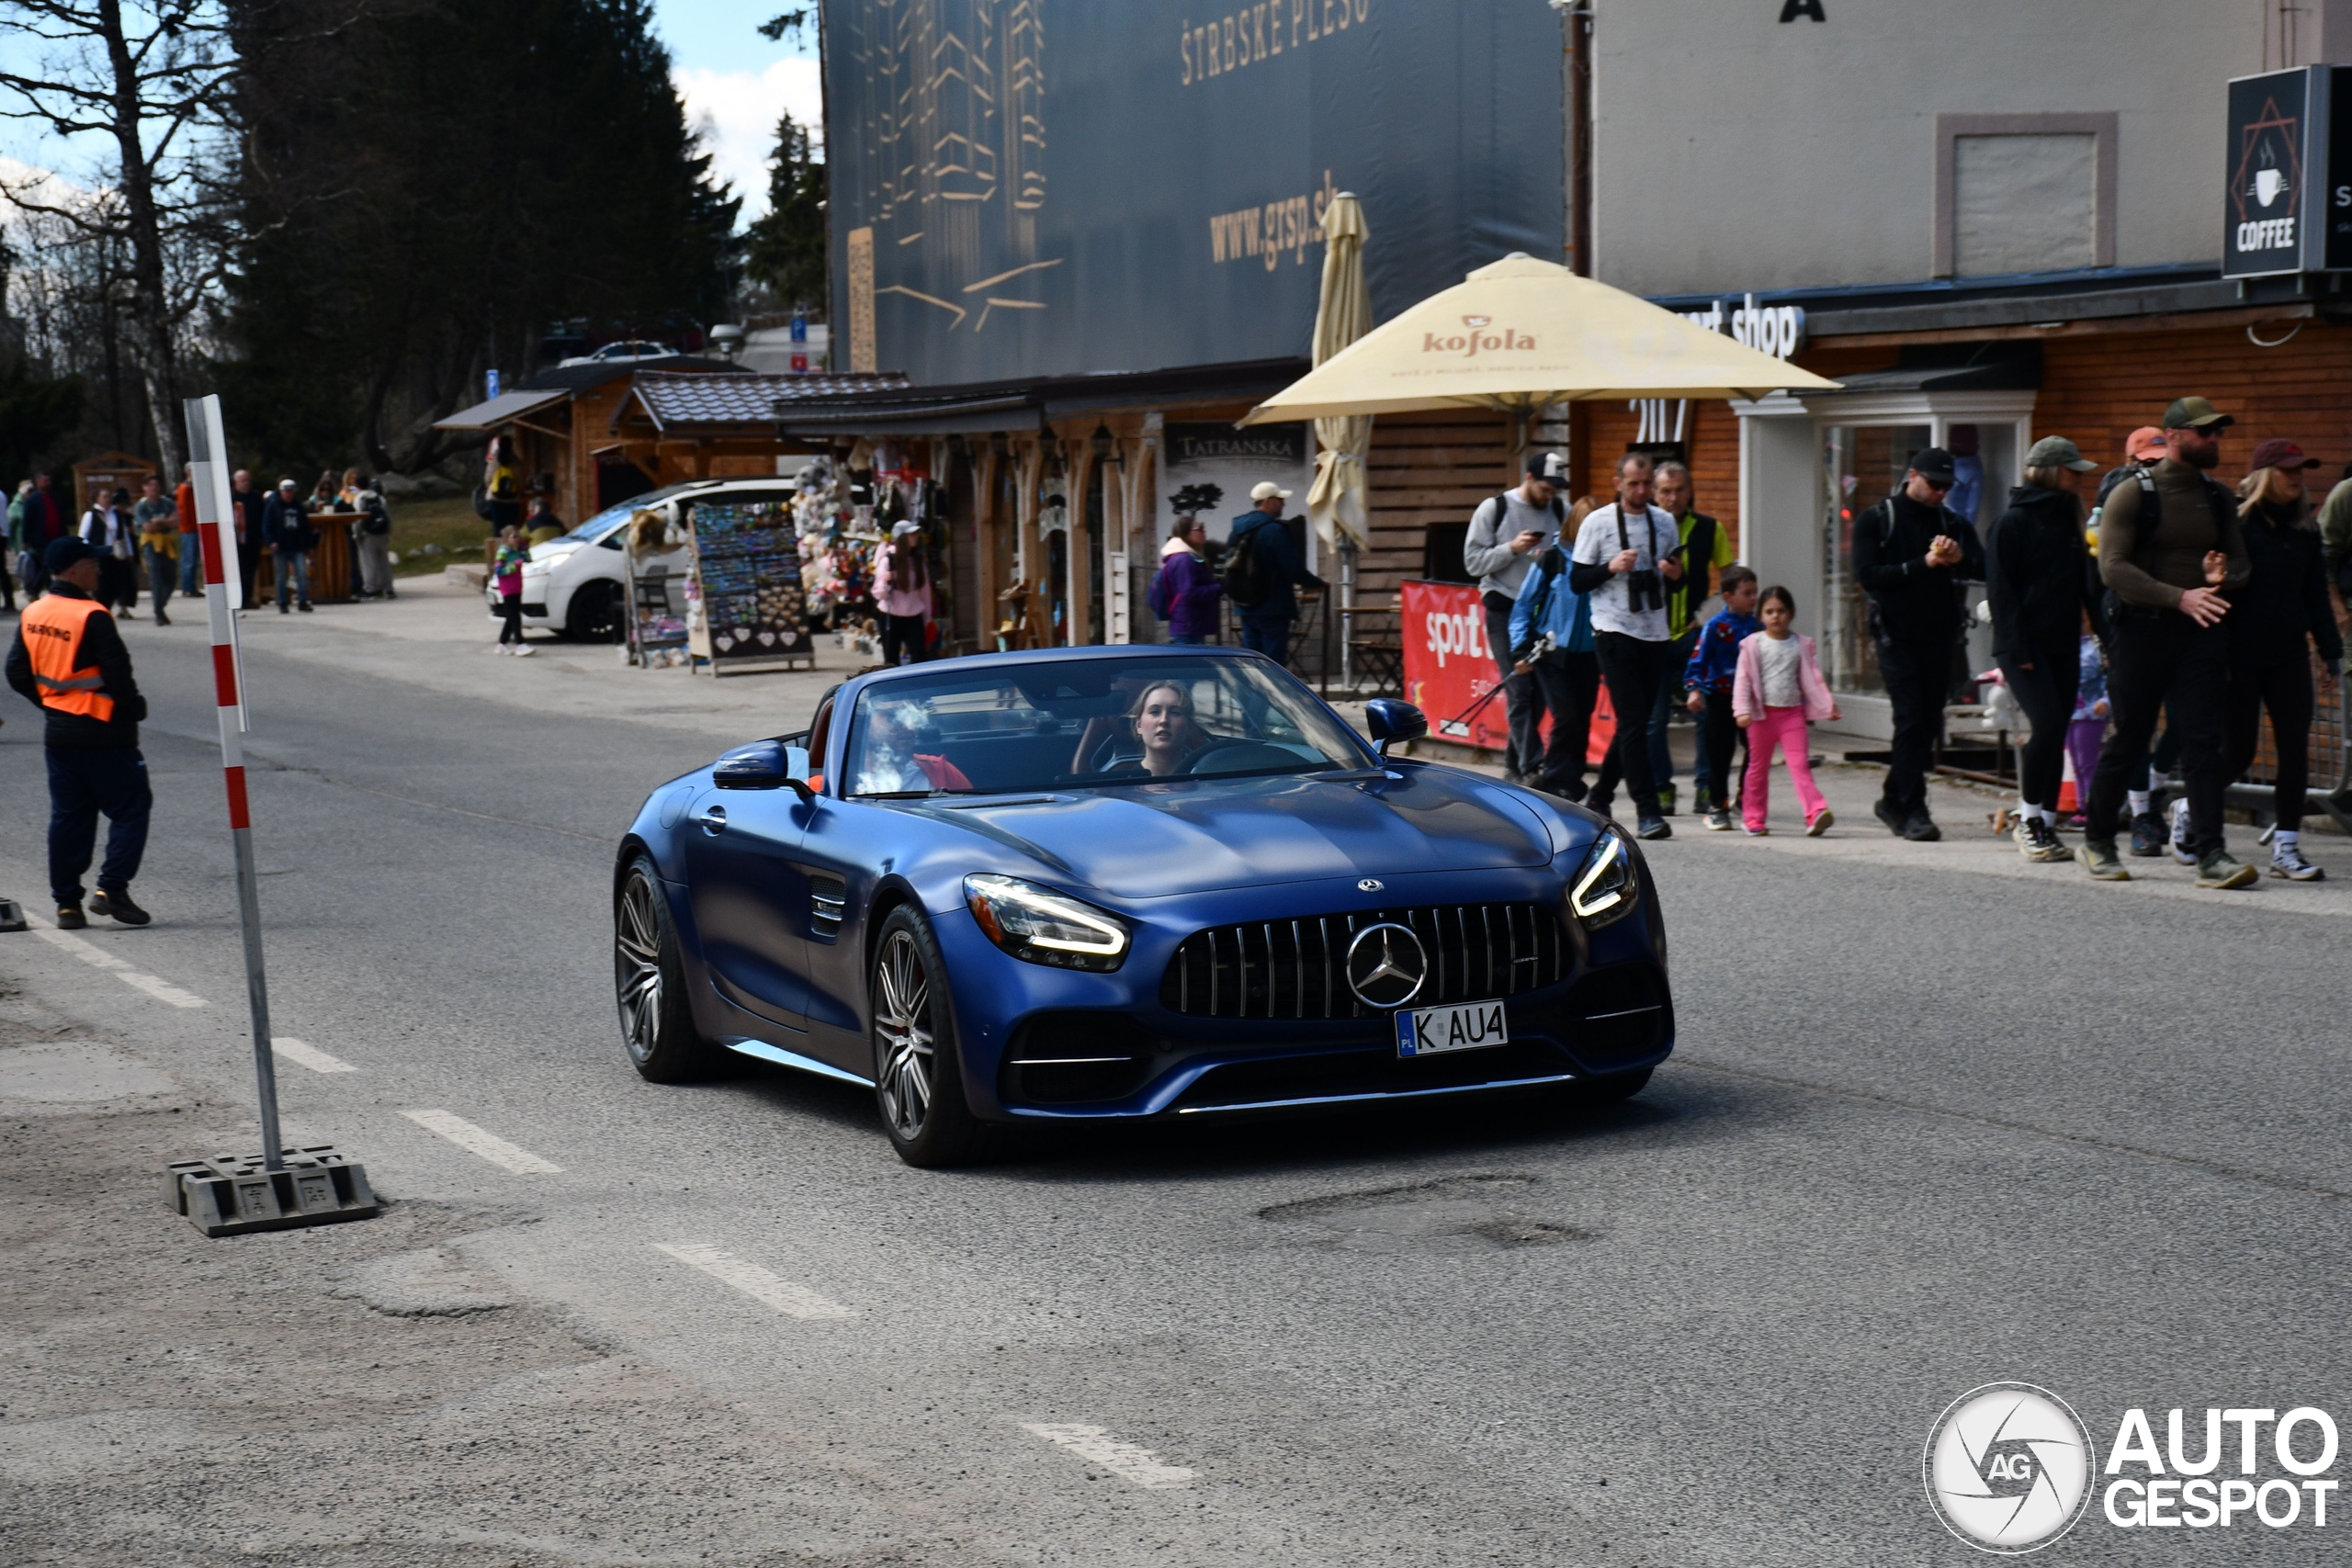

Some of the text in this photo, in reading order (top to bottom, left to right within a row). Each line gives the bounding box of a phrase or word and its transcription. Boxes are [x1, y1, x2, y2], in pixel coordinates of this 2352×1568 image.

[2237, 217, 2296, 253] COFFEE
[1422, 329, 1536, 357] kofola
[1732, 292, 1797, 362] shop
[1426, 604, 1483, 668] sport
[1401, 1039, 1413, 1049] PL
[1415, 1005, 1504, 1050] K AU4
